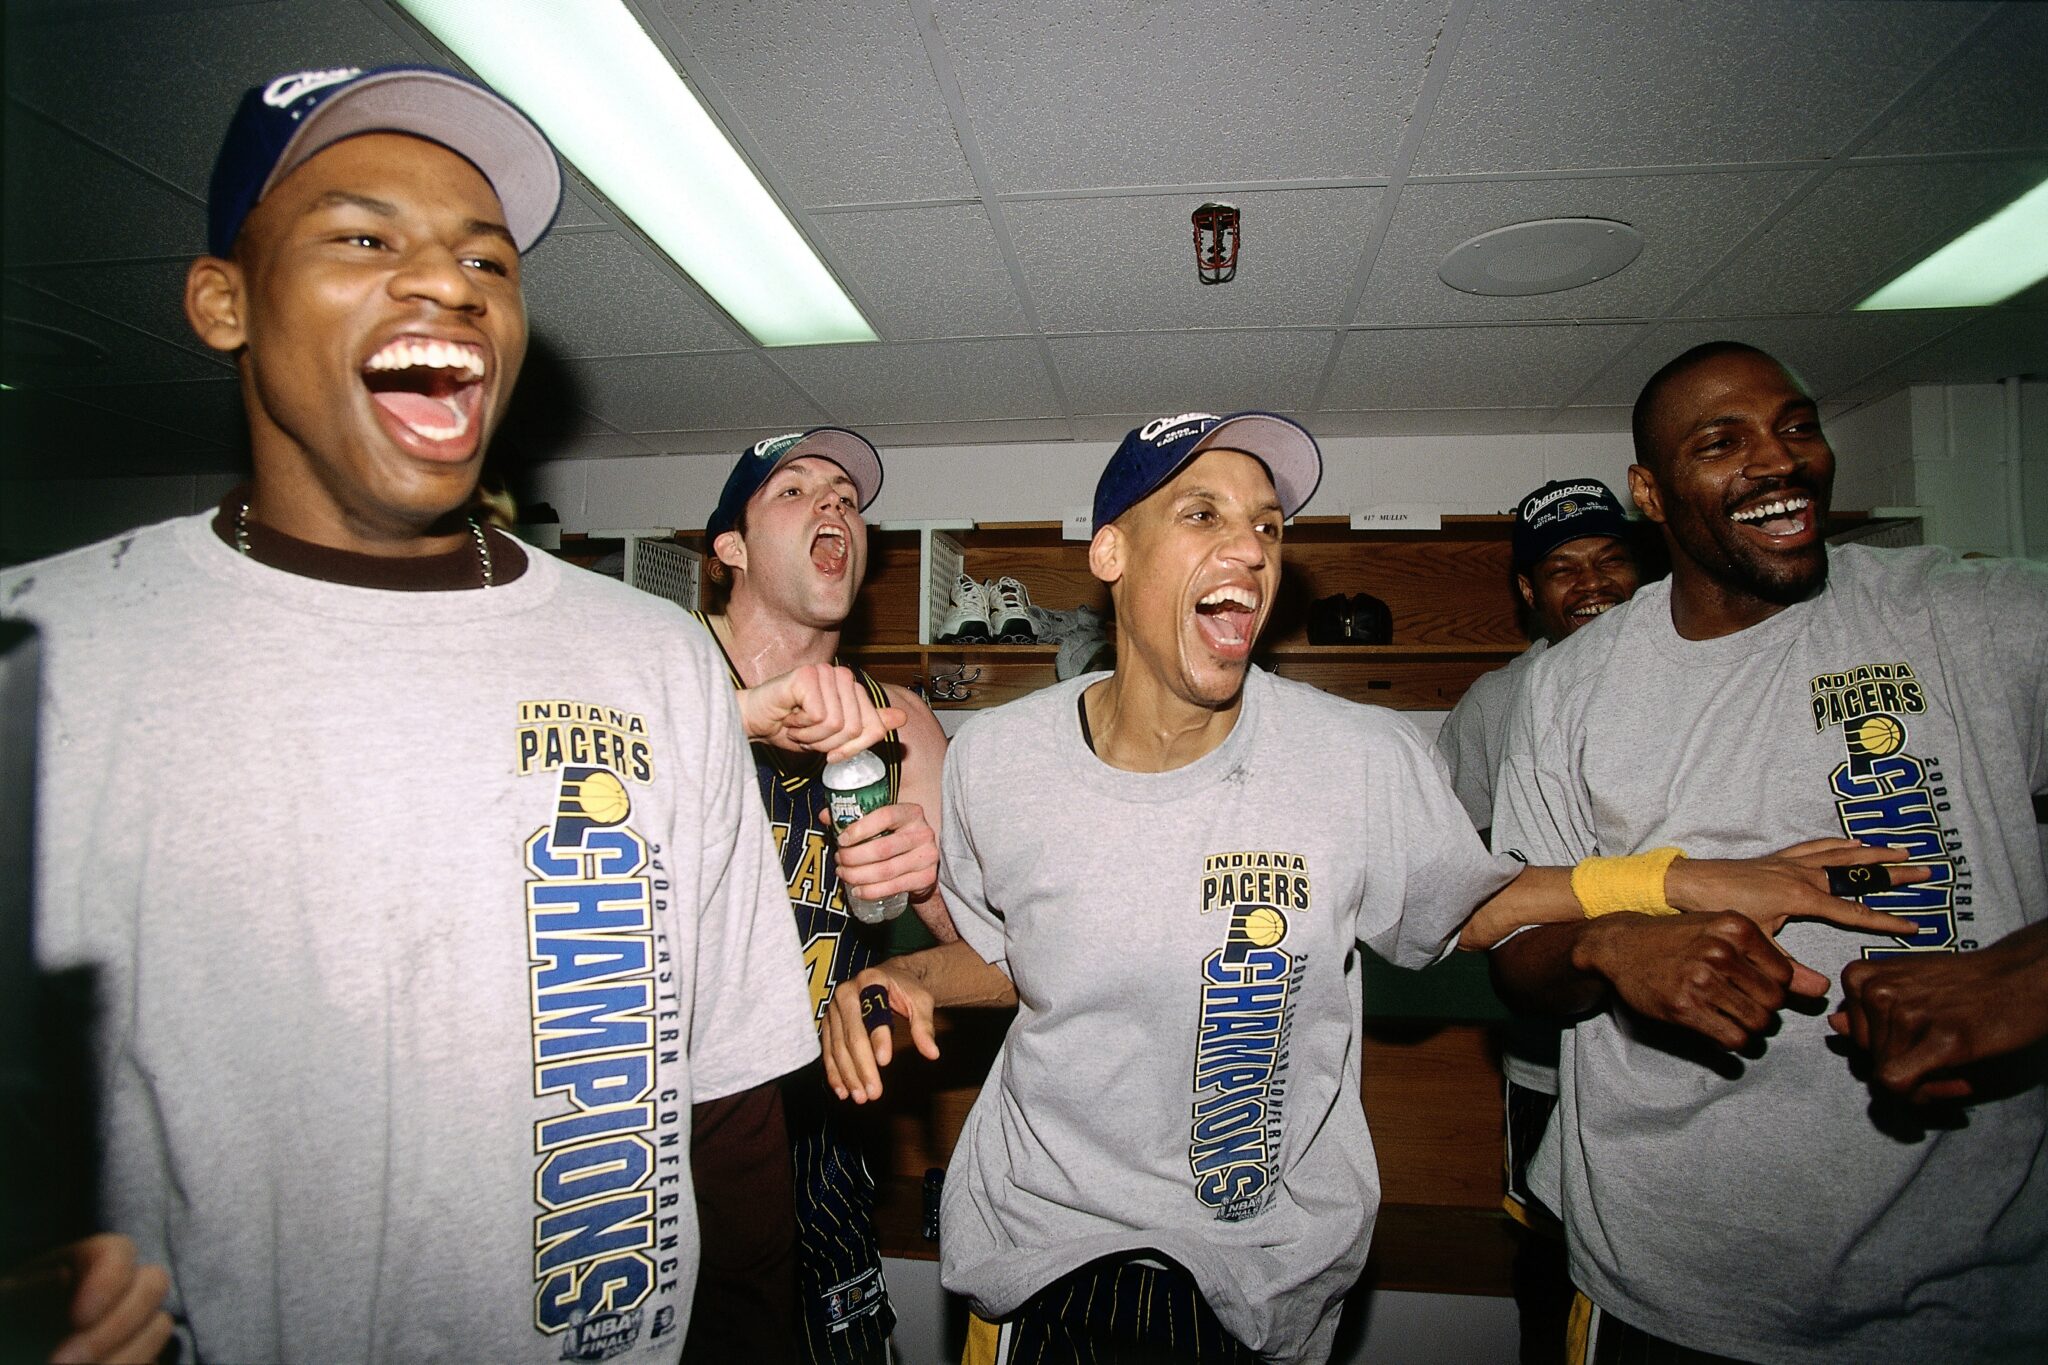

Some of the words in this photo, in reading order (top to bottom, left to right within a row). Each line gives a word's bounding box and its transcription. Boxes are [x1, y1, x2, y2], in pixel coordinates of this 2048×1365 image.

[1523, 484, 1604, 523] Champions
[1809, 662, 1916, 696] INDIANA
[518, 700, 649, 738] INDIANA
[1811, 681, 1928, 735] PACERS
[515, 724, 656, 786] PACERS
[1925, 757, 1951, 812] 2000
[1943, 828, 1975, 921] EASTERN
[1204, 851, 1309, 874] INDIANA
[1200, 870, 1312, 915] PACERS
[1289, 954, 1309, 995] 2000
[658, 934, 679, 1064] EASTERN
[862, 993, 888, 1017] 31
[524, 824, 656, 1337] CHAMPIONS
[1189, 947, 1294, 1209] CHAMPIONS
[1268, 1079, 1286, 1187] CONFERENCE
[660, 1088, 679, 1295] CONFERENCE
[1228, 1198, 1256, 1213] NBA
[580, 1329, 639, 1355] FINALS
[582, 1312, 632, 1342] NBA
